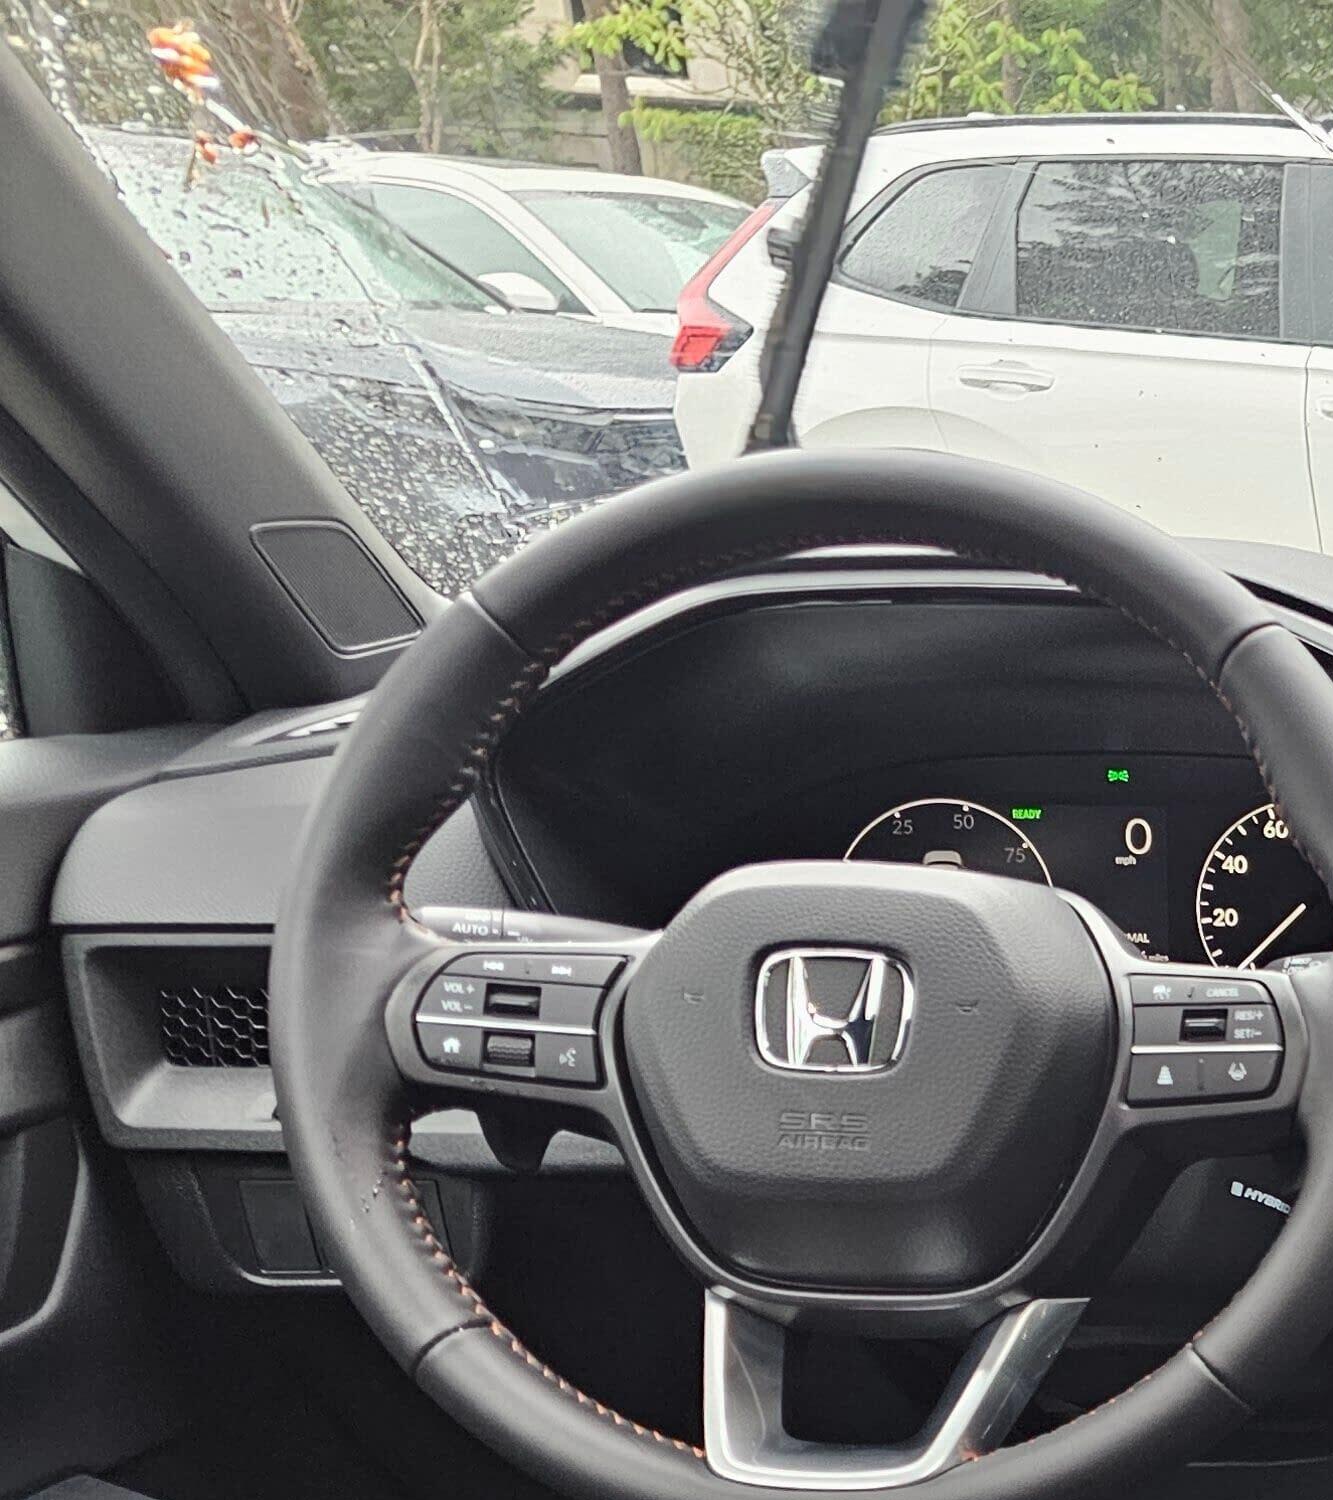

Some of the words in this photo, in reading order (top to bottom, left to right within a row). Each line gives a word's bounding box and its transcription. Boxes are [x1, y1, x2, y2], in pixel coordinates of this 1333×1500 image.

[953, 814, 975, 830] 50
[1012, 809, 1042, 820] READY
[892, 819, 913, 835] 25
[1263, 820, 1289, 839] 60
[1125, 818, 1152, 855] 0
[1004, 847, 1026, 863] 75
[1115, 855, 1136, 866] mph
[1221, 855, 1248, 874] 40
[1212, 908, 1239, 927] 20
[452, 922, 488, 936] AUTO
[1125, 933, 1150, 943] MAL
[444, 981, 464, 994] VOL
[441, 1000, 462, 1012] VOL
[779, 1110, 869, 1131] SRS
[777, 1134, 871, 1150] AIRBAG
